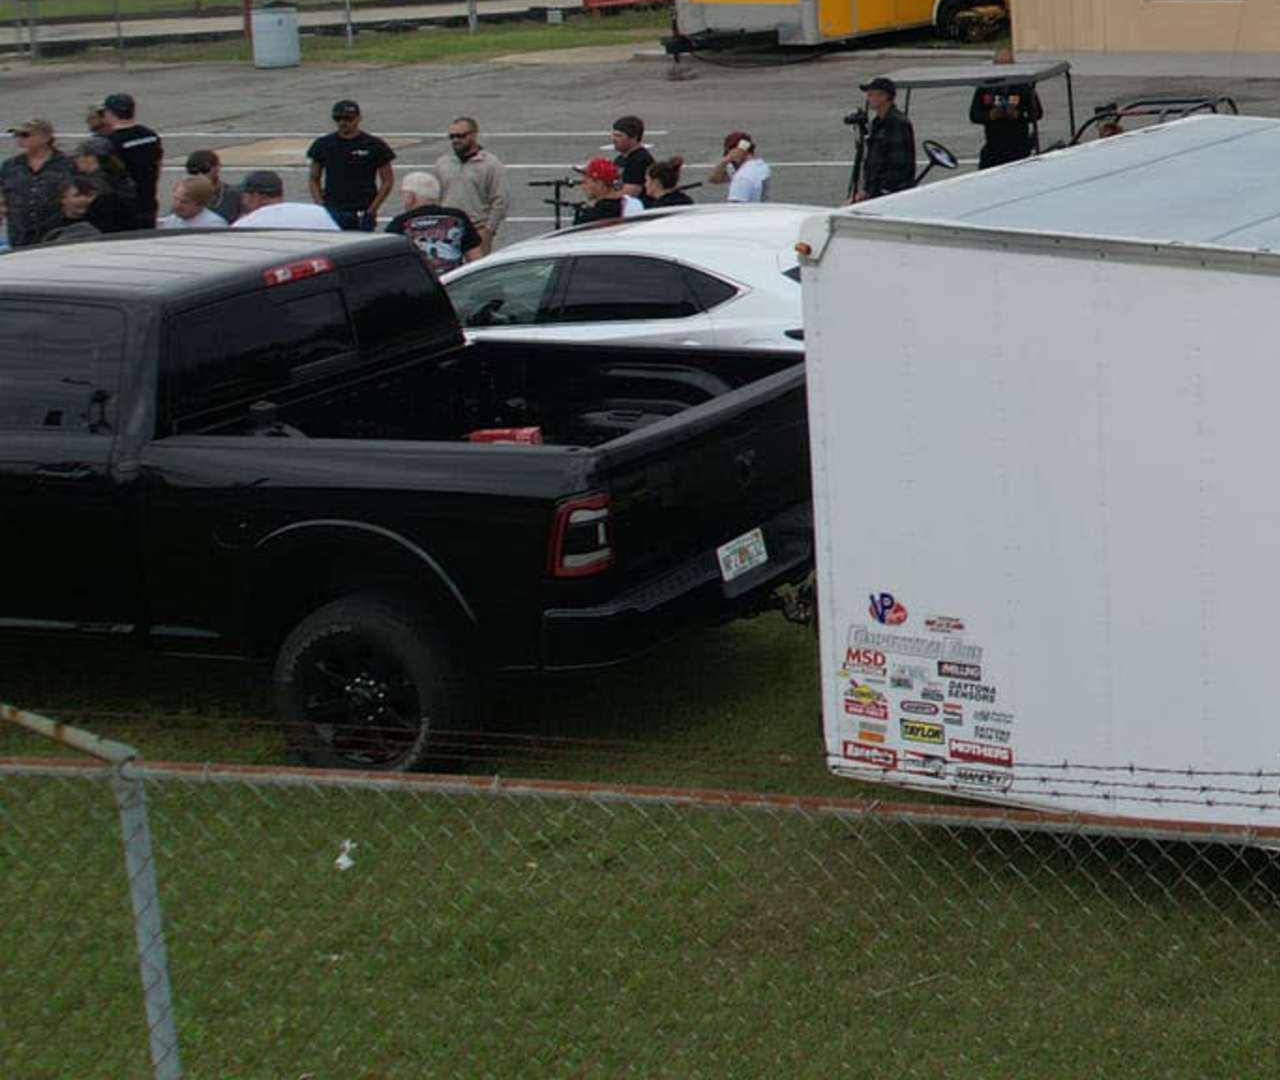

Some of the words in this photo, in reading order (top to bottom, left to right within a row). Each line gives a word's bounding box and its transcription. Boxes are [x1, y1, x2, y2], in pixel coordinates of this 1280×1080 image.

[869, 591, 895, 624] VP
[846, 647, 887, 667] MSD
[904, 724, 943, 740] TAYLOR
